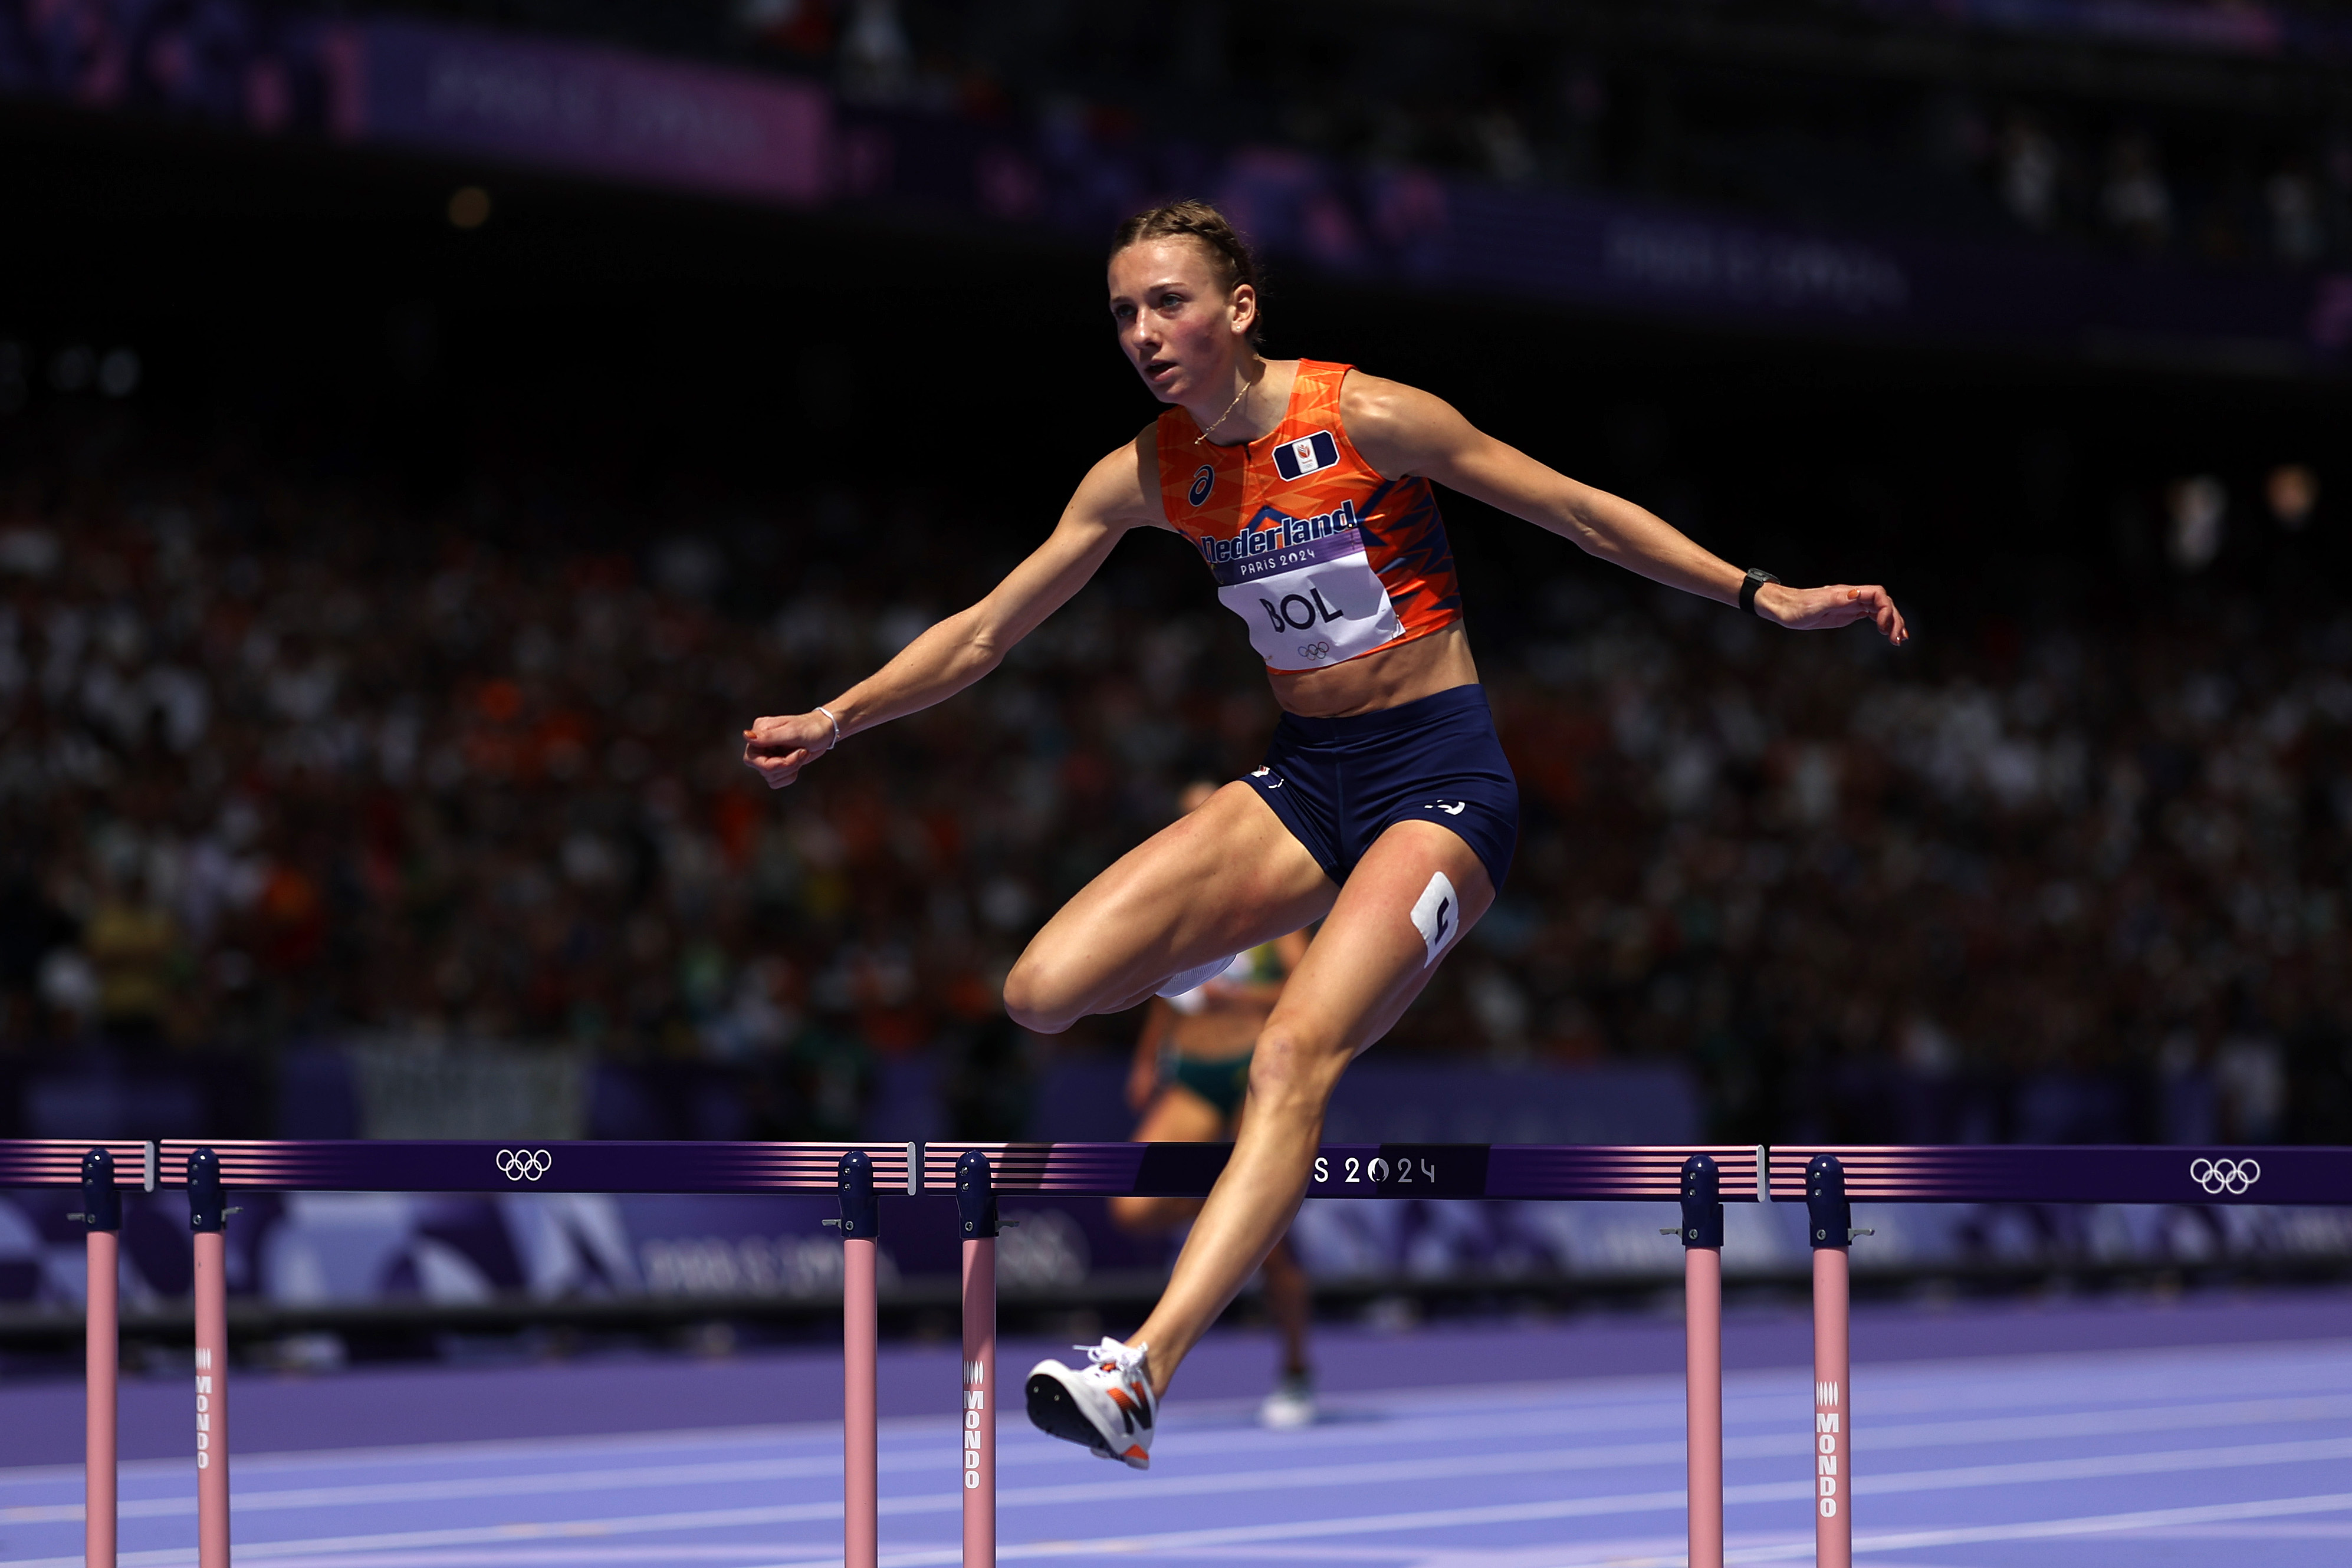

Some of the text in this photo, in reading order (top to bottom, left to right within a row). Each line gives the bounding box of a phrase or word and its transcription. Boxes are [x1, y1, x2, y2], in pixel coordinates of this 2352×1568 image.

[1280, 549, 1315, 566] 2024
[1259, 587, 1343, 634] BOL
[1344, 1157, 1435, 1184] 2024
[195, 1376, 212, 1469] MONDO
[963, 1391, 984, 1489] MONDO
[1816, 1413, 1839, 1518] MONDO
